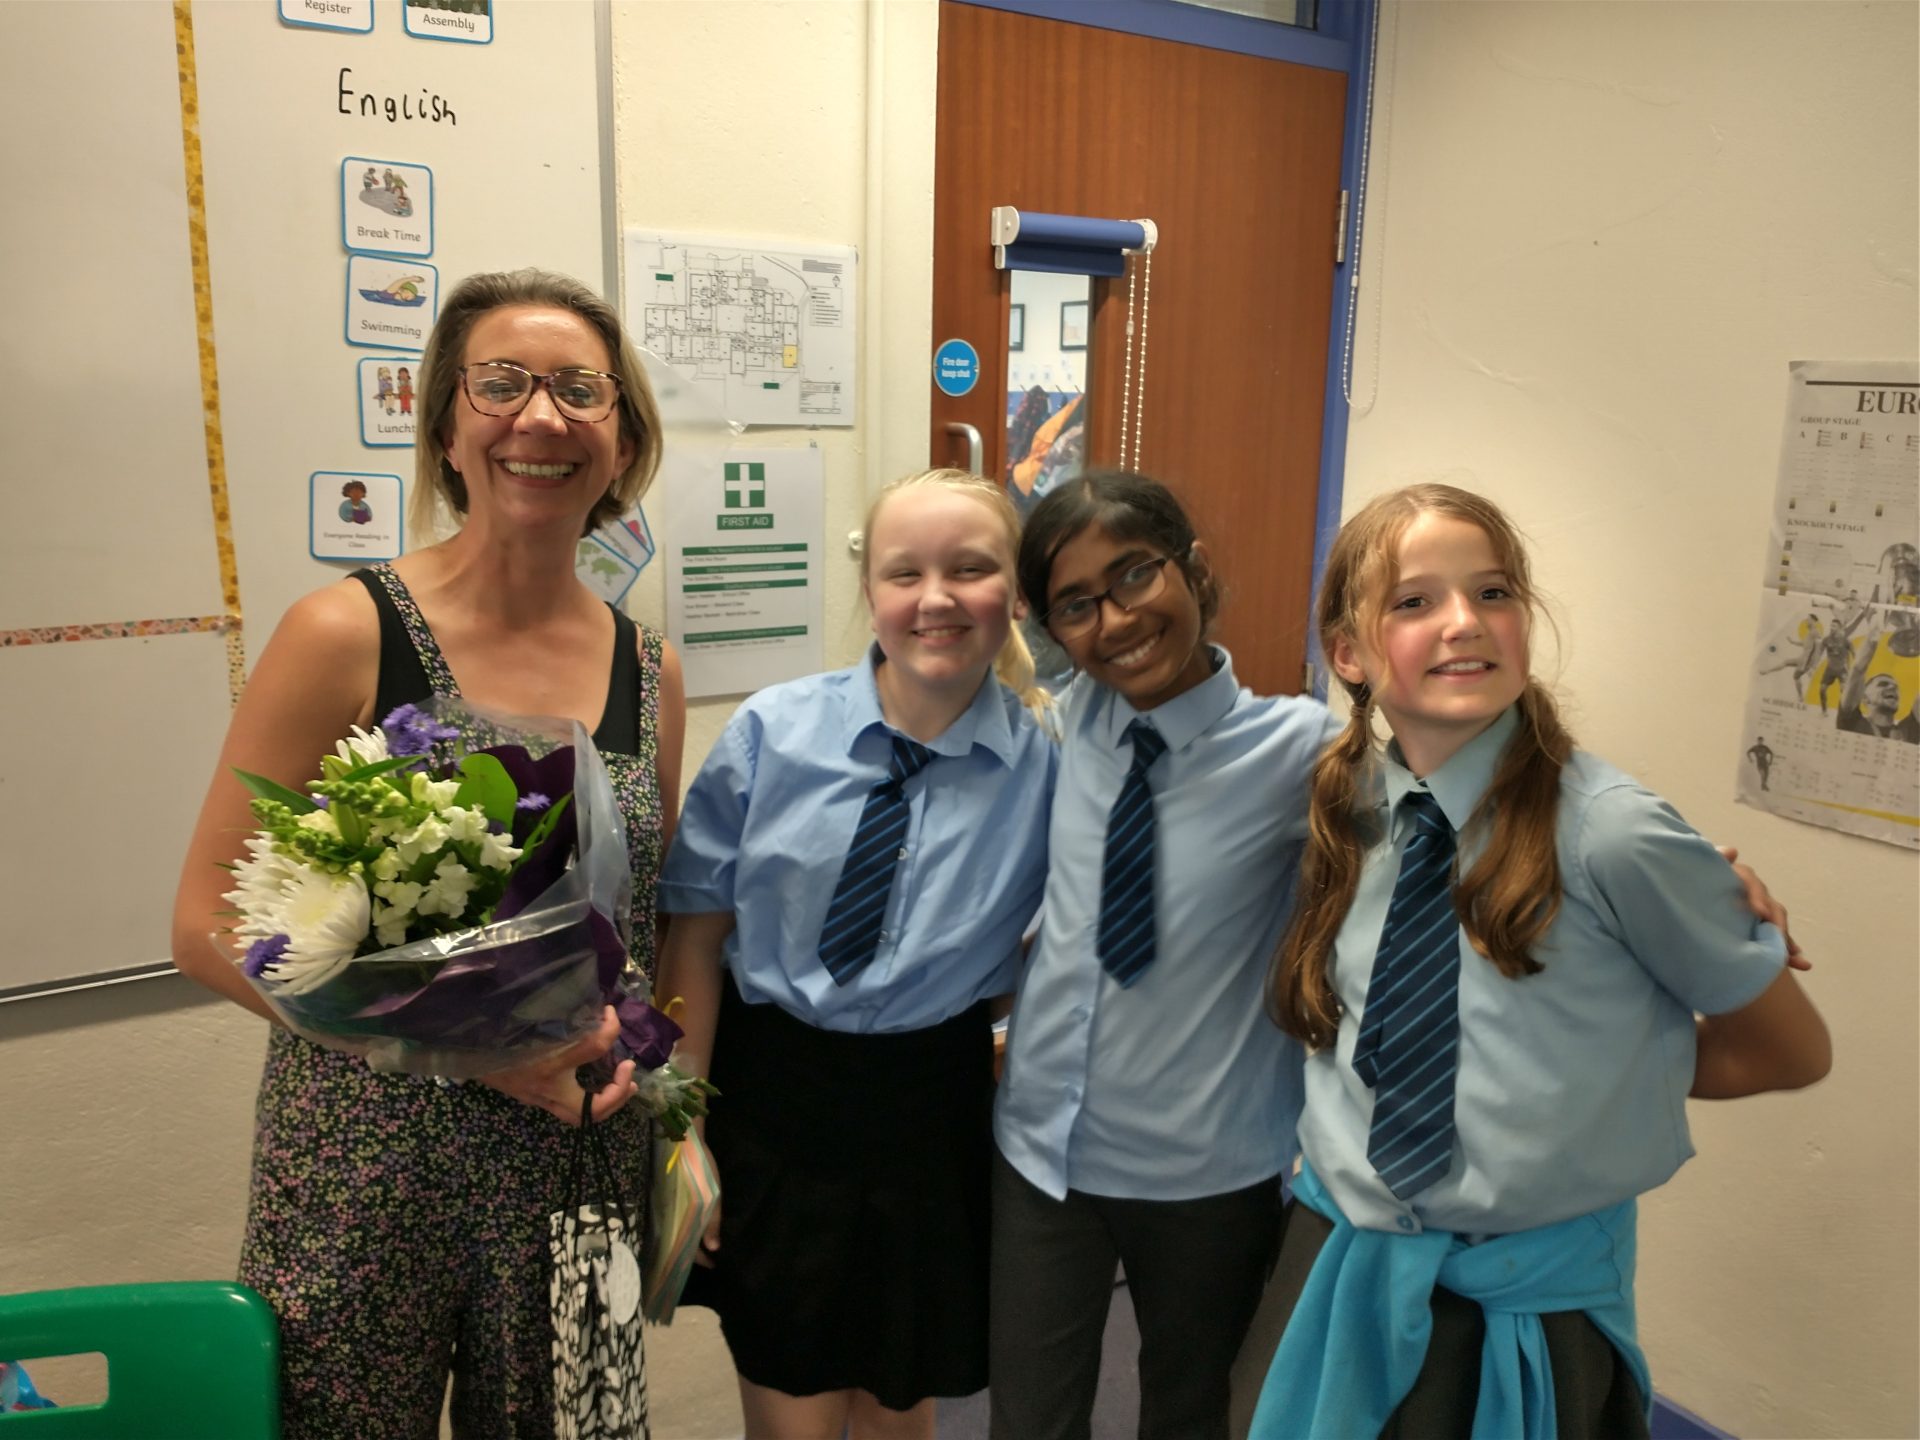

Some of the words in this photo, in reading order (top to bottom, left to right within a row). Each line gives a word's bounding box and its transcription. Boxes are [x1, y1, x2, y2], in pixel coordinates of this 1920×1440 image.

[304, 0, 352, 14] Register
[423, 14, 475, 32] Assembly
[338, 68, 456, 125] English
[357, 226, 390, 240] Break
[393, 229, 422, 242] Time
[361, 319, 422, 340] Swimming
[943, 357, 955, 366] Fire
[1856, 390, 1920, 414] EUR
[1800, 416, 1832, 425] GROUP
[1833, 417, 1861, 426] STAGE
[722, 516, 750, 527] FIRST
[752, 516, 769, 526] AID
[1787, 518, 1834, 530] KNOCKOUT
[1836, 523, 1866, 533] STAGE
